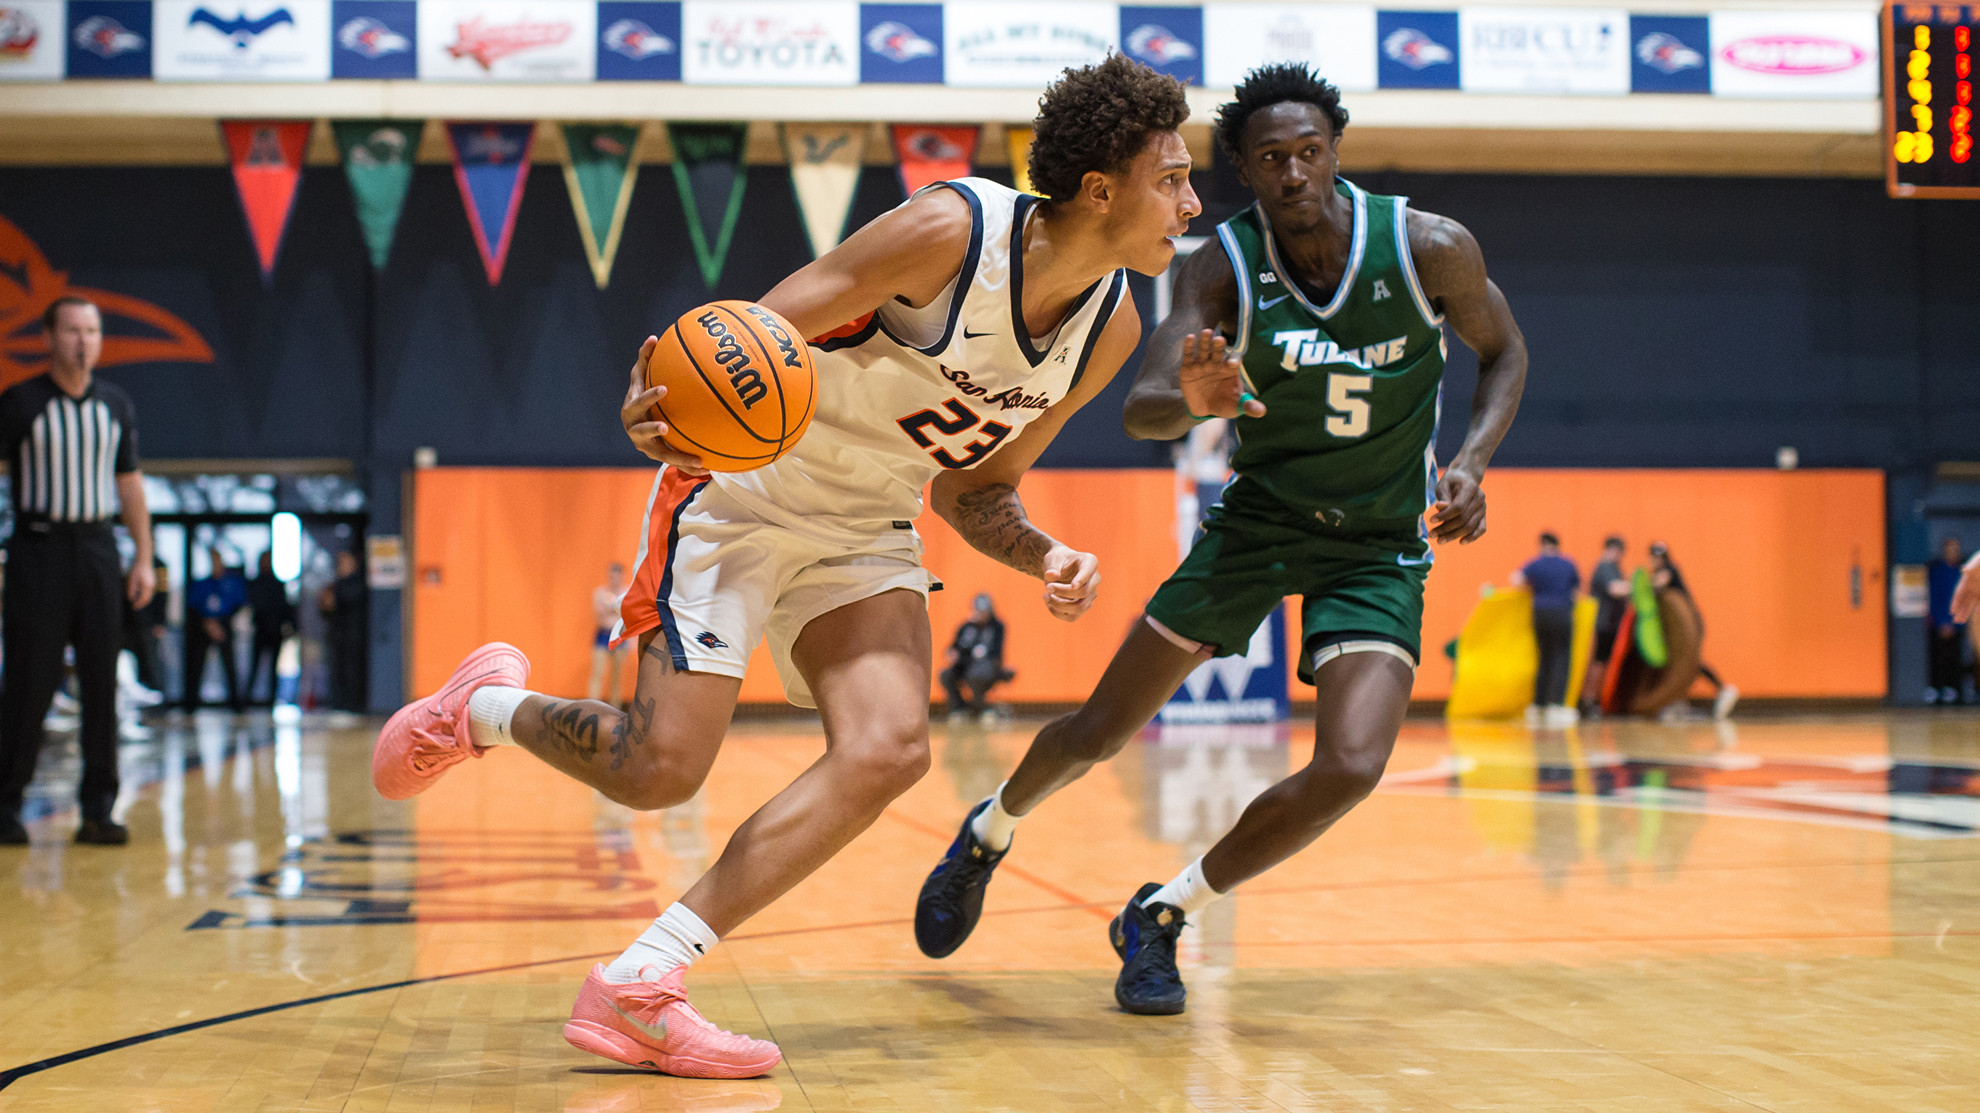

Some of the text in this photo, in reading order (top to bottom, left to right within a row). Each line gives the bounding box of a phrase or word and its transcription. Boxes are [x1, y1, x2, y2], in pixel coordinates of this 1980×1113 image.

[697, 40, 845, 68] TOYOTA
[1258, 271, 1277, 285] GG
[1372, 279, 1392, 302] A
[744, 306, 803, 369] NCAA
[1272, 328, 1408, 373] TULANE
[696, 310, 769, 412] Wilson
[939, 363, 987, 398] San
[1323, 371, 1374, 438] 5
[895, 396, 1014, 471] 23
